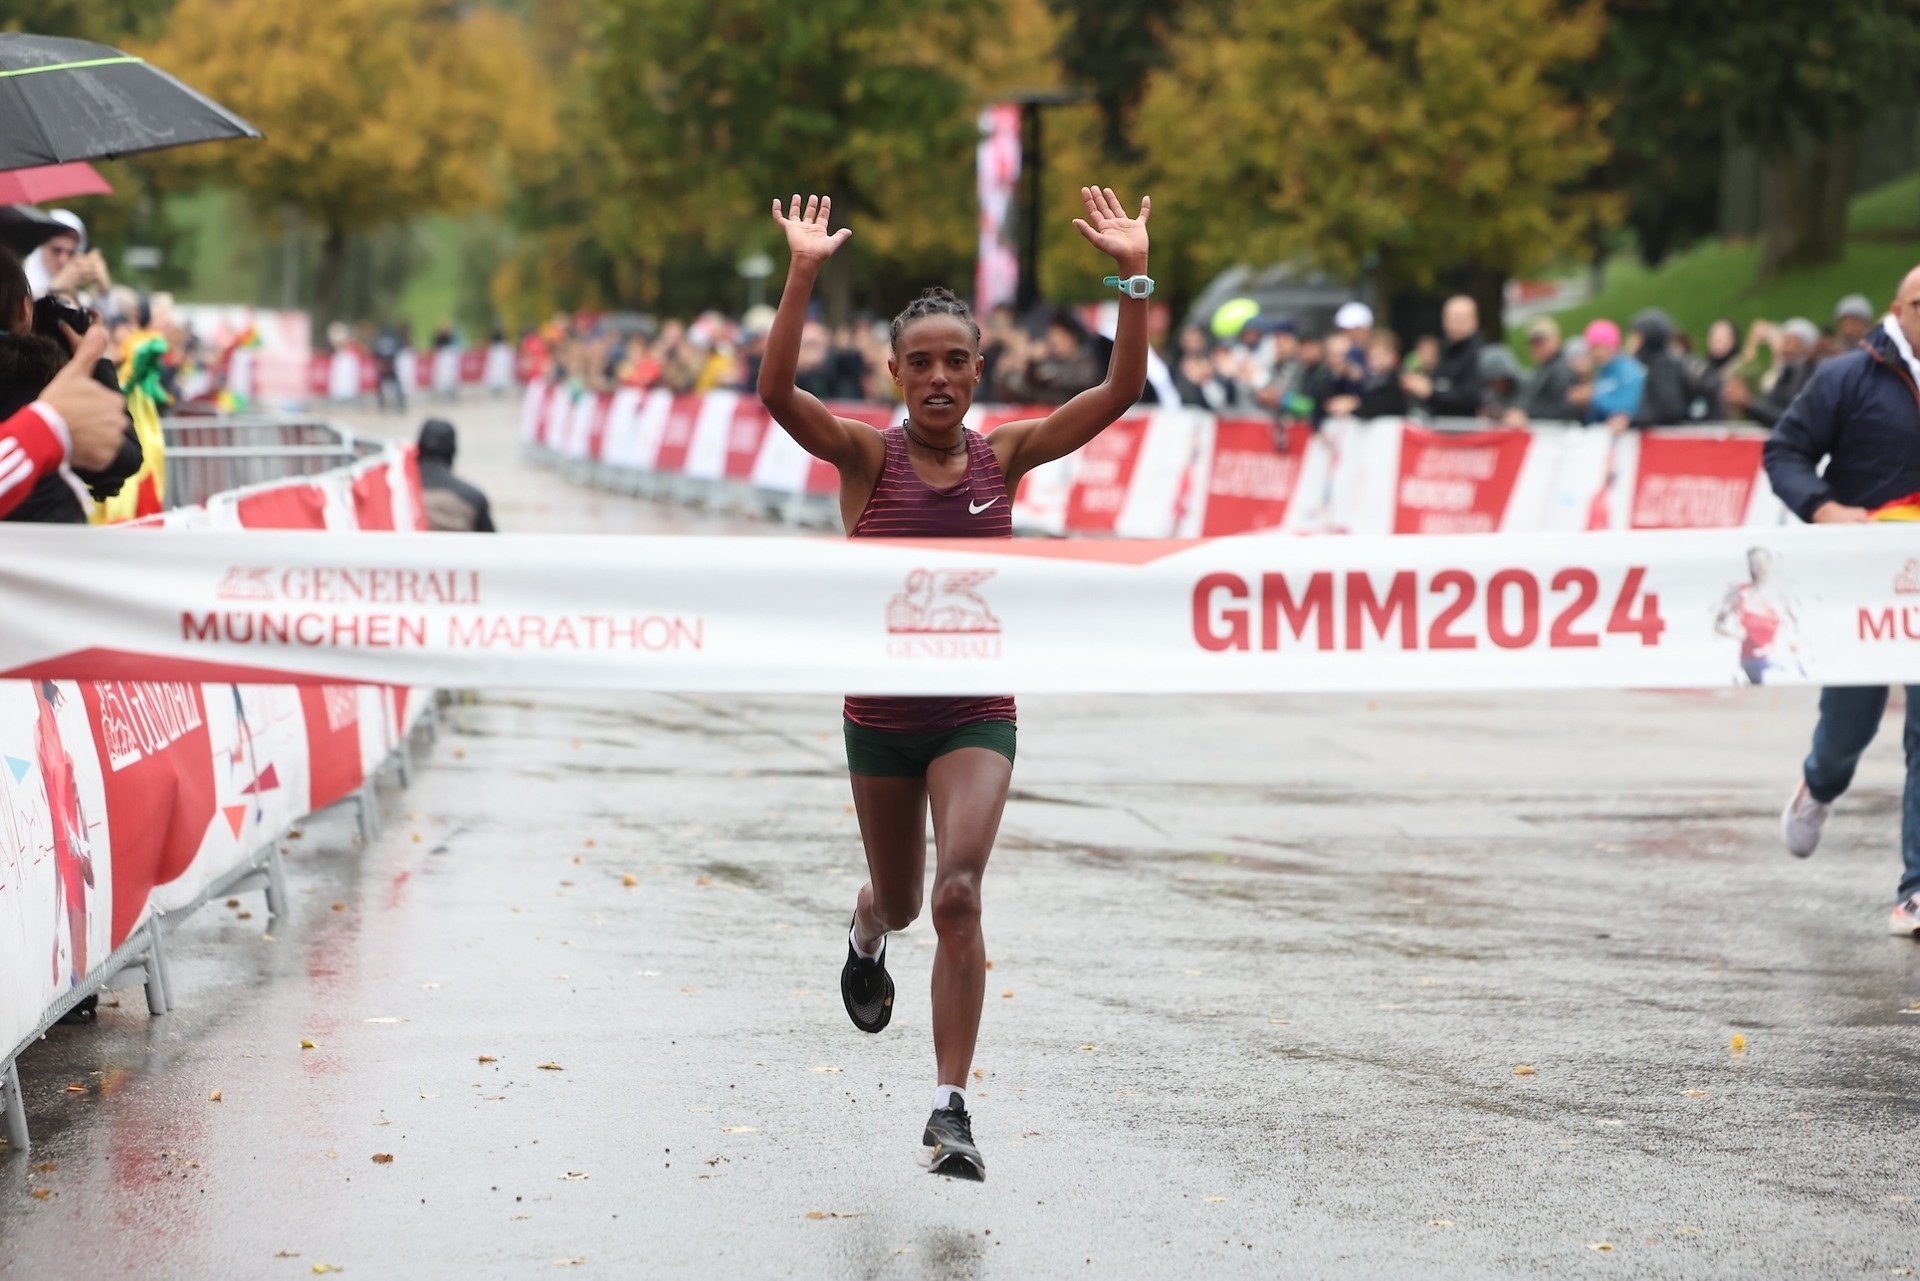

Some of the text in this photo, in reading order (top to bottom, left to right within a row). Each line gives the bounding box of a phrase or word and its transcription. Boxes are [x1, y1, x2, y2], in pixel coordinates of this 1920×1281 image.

[281, 568, 480, 604] GENERALI
[1191, 566, 1667, 652] GMM2024
[180, 610, 705, 651] MÜNCHEN MARATHON
